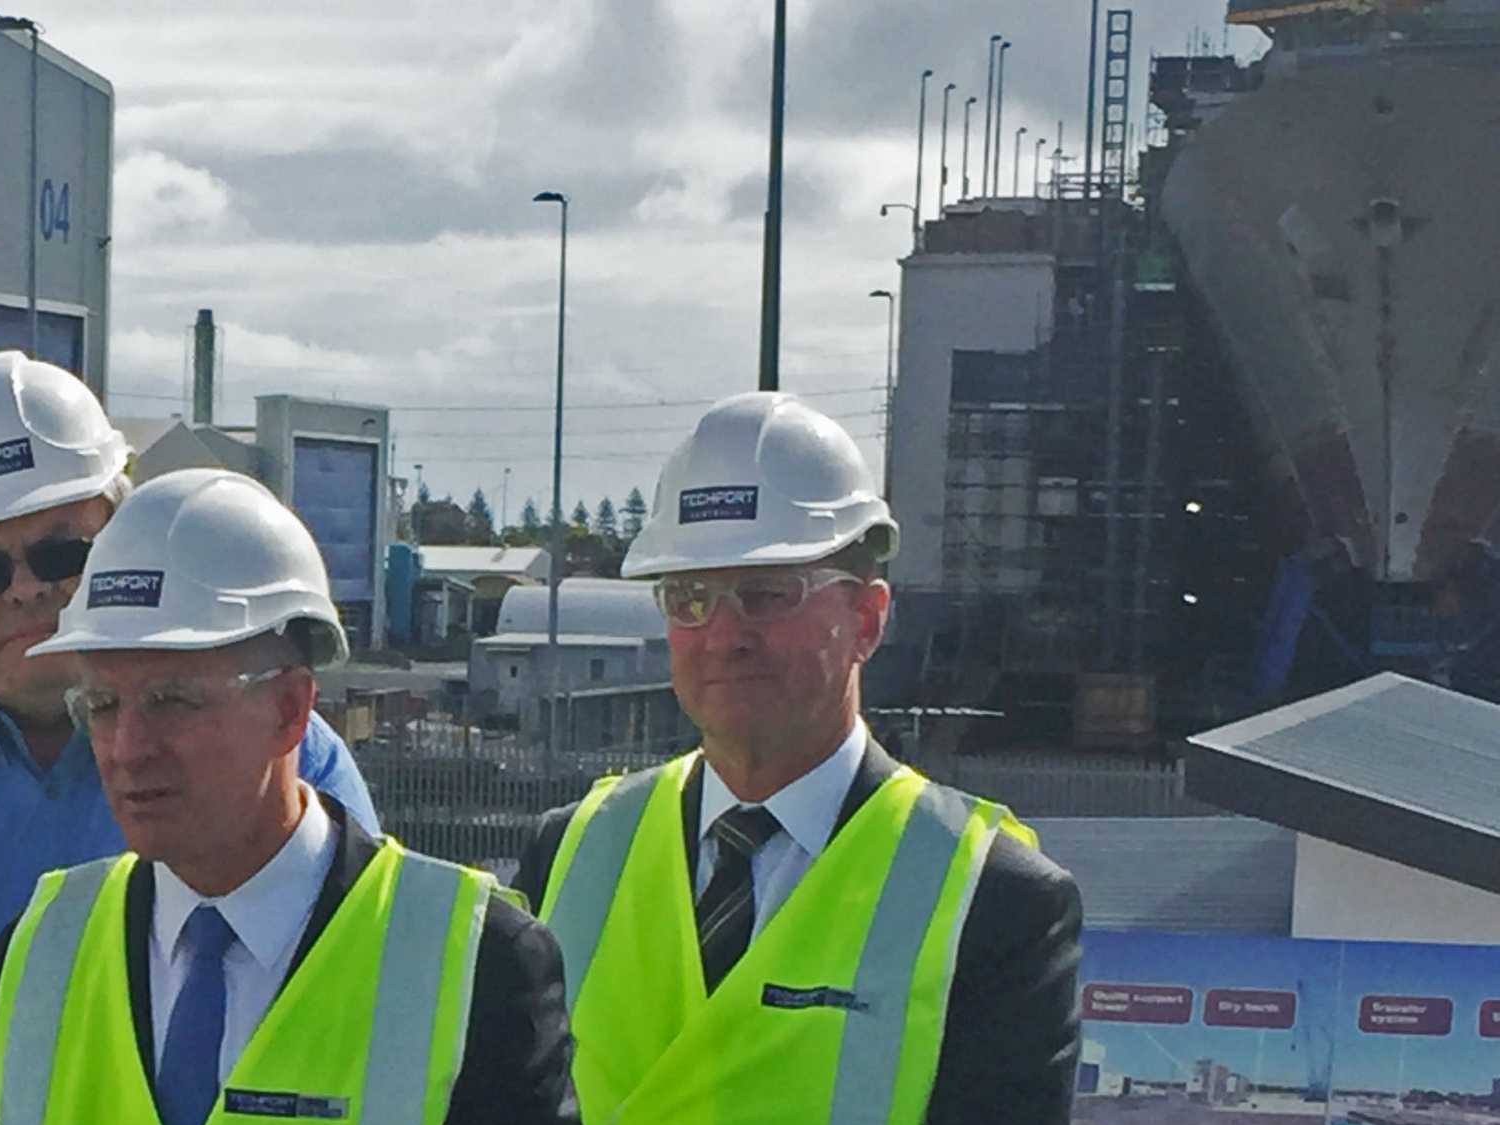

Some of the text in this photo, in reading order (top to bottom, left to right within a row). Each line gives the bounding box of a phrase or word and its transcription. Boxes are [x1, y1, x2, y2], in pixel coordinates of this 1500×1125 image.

[39, 178, 70, 245] 04
[681, 490, 755, 507] TECHPORT
[91, 575, 161, 592] TECHPORT
